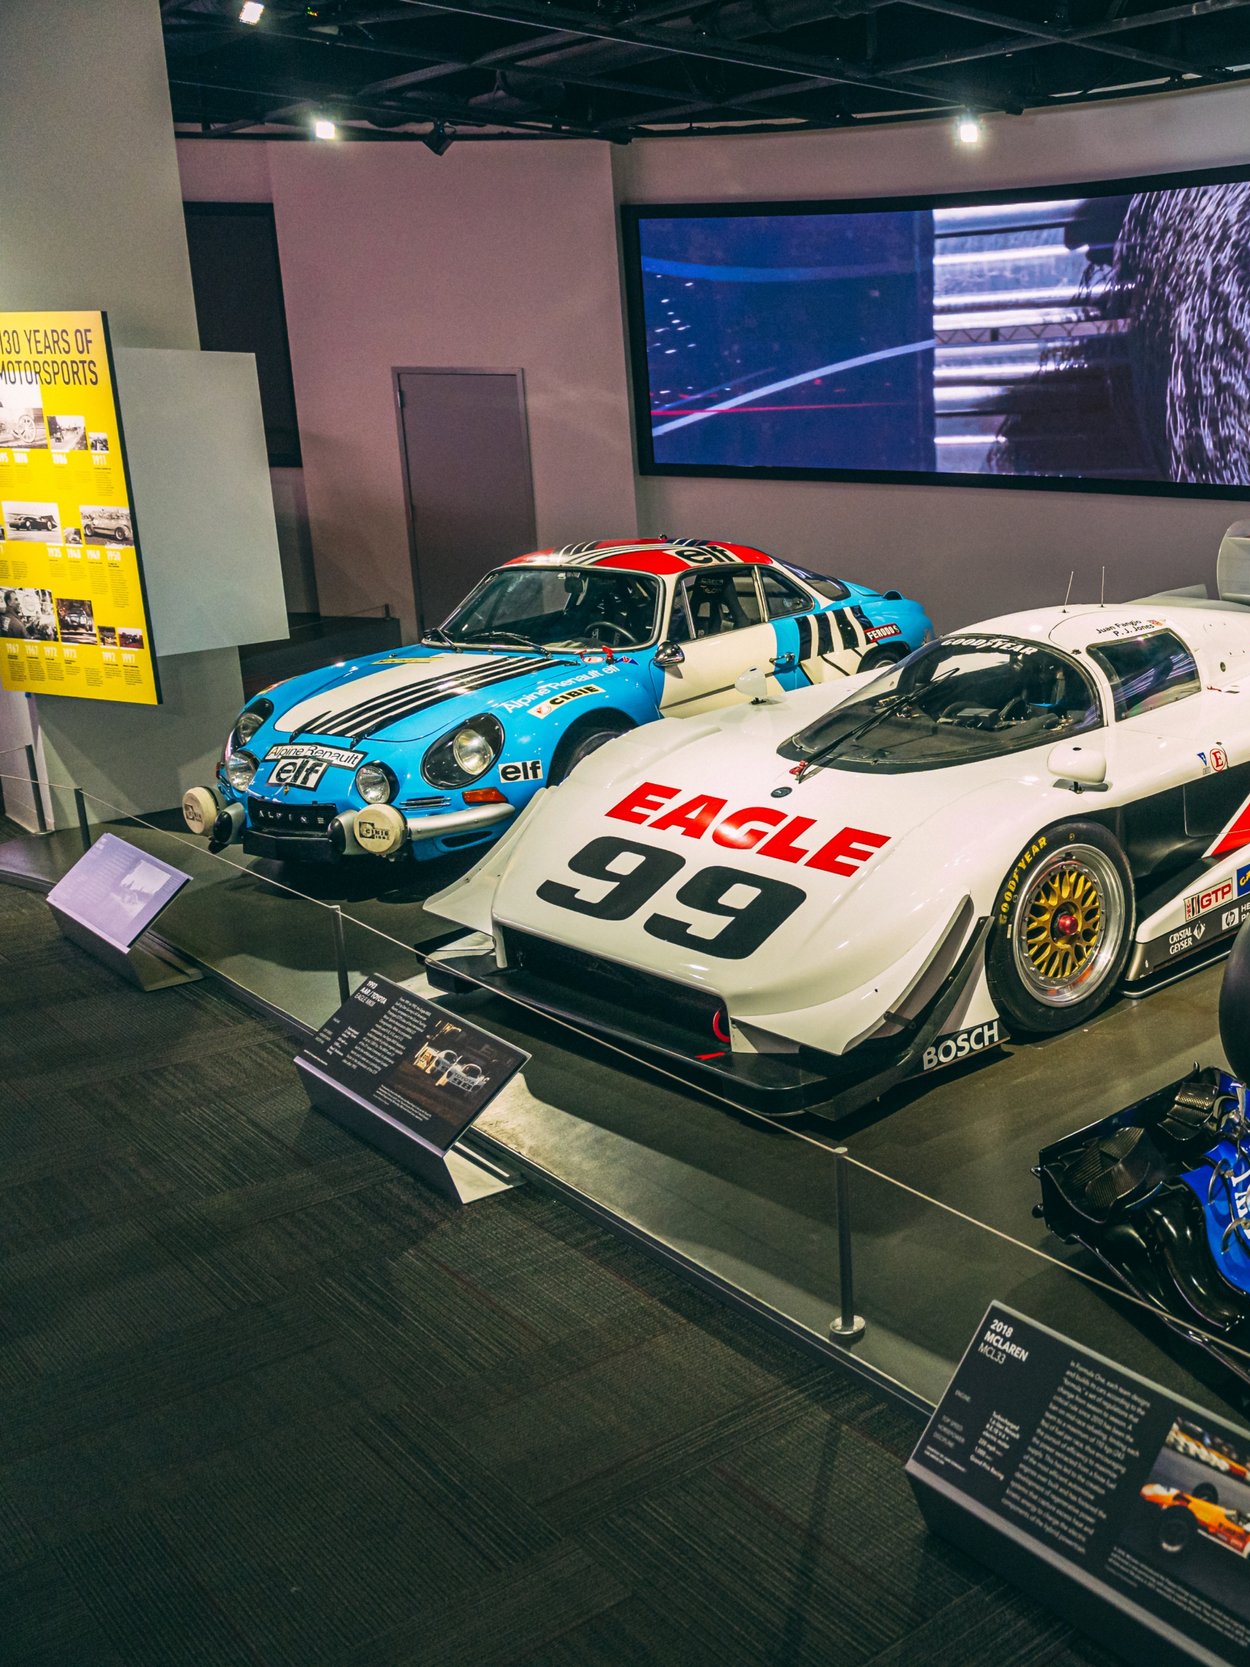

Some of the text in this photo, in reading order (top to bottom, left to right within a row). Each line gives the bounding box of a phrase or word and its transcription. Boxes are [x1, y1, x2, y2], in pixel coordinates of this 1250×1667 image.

[24, 329, 70, 354] YEARS
[75, 328, 92, 354] OF
[675, 546, 736, 564] elf
[1096, 622, 1115, 635] Juan
[1133, 623, 1155, 634] Jones
[941, 638, 1039, 656] GOODYEAR
[502, 687, 550, 713] Alpine
[551, 670, 602, 691] Renault
[549, 686, 600, 706] CIBIE
[268, 746, 303, 758] Alpine
[275, 759, 322, 787] elf
[500, 761, 542, 782] elf
[258, 809, 326, 825] ALPINE
[604, 781, 892, 877] EAGLE
[999, 836, 1048, 924] GOODYEAR
[535, 836, 807, 961] 99
[1200, 883, 1232, 910] GTP
[1168, 927, 1193, 945] CRYSTAL
[1169, 937, 1193, 955] GEYSER
[370, 992, 388, 1004] TOYOTA
[922, 1021, 999, 1071] BOSCH
[990, 1319, 1014, 1337] 2018
[978, 1342, 1006, 1364] MCL33
[984, 1331, 1028, 1361] MCLAREN
